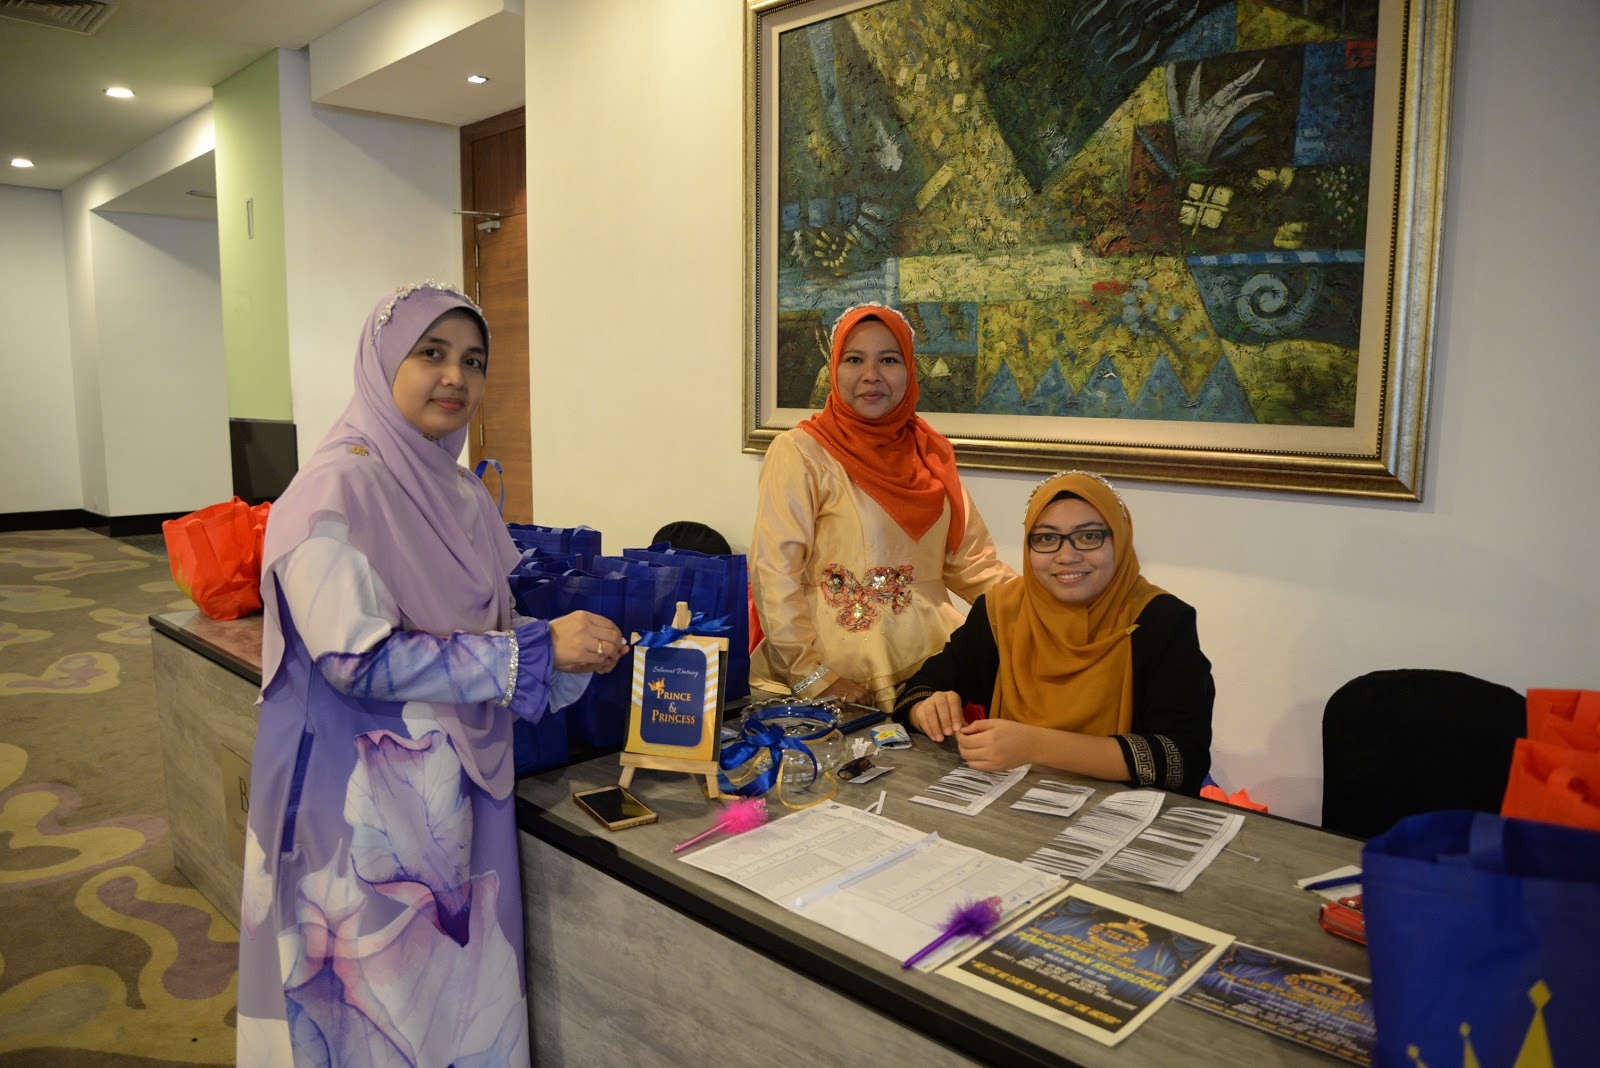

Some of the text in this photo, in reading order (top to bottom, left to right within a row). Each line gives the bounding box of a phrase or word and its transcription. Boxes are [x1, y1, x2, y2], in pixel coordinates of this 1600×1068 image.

[656, 688, 692, 702] PRINCE
[668, 701, 677, 714] &
[652, 709, 696, 724] PRINCESS
